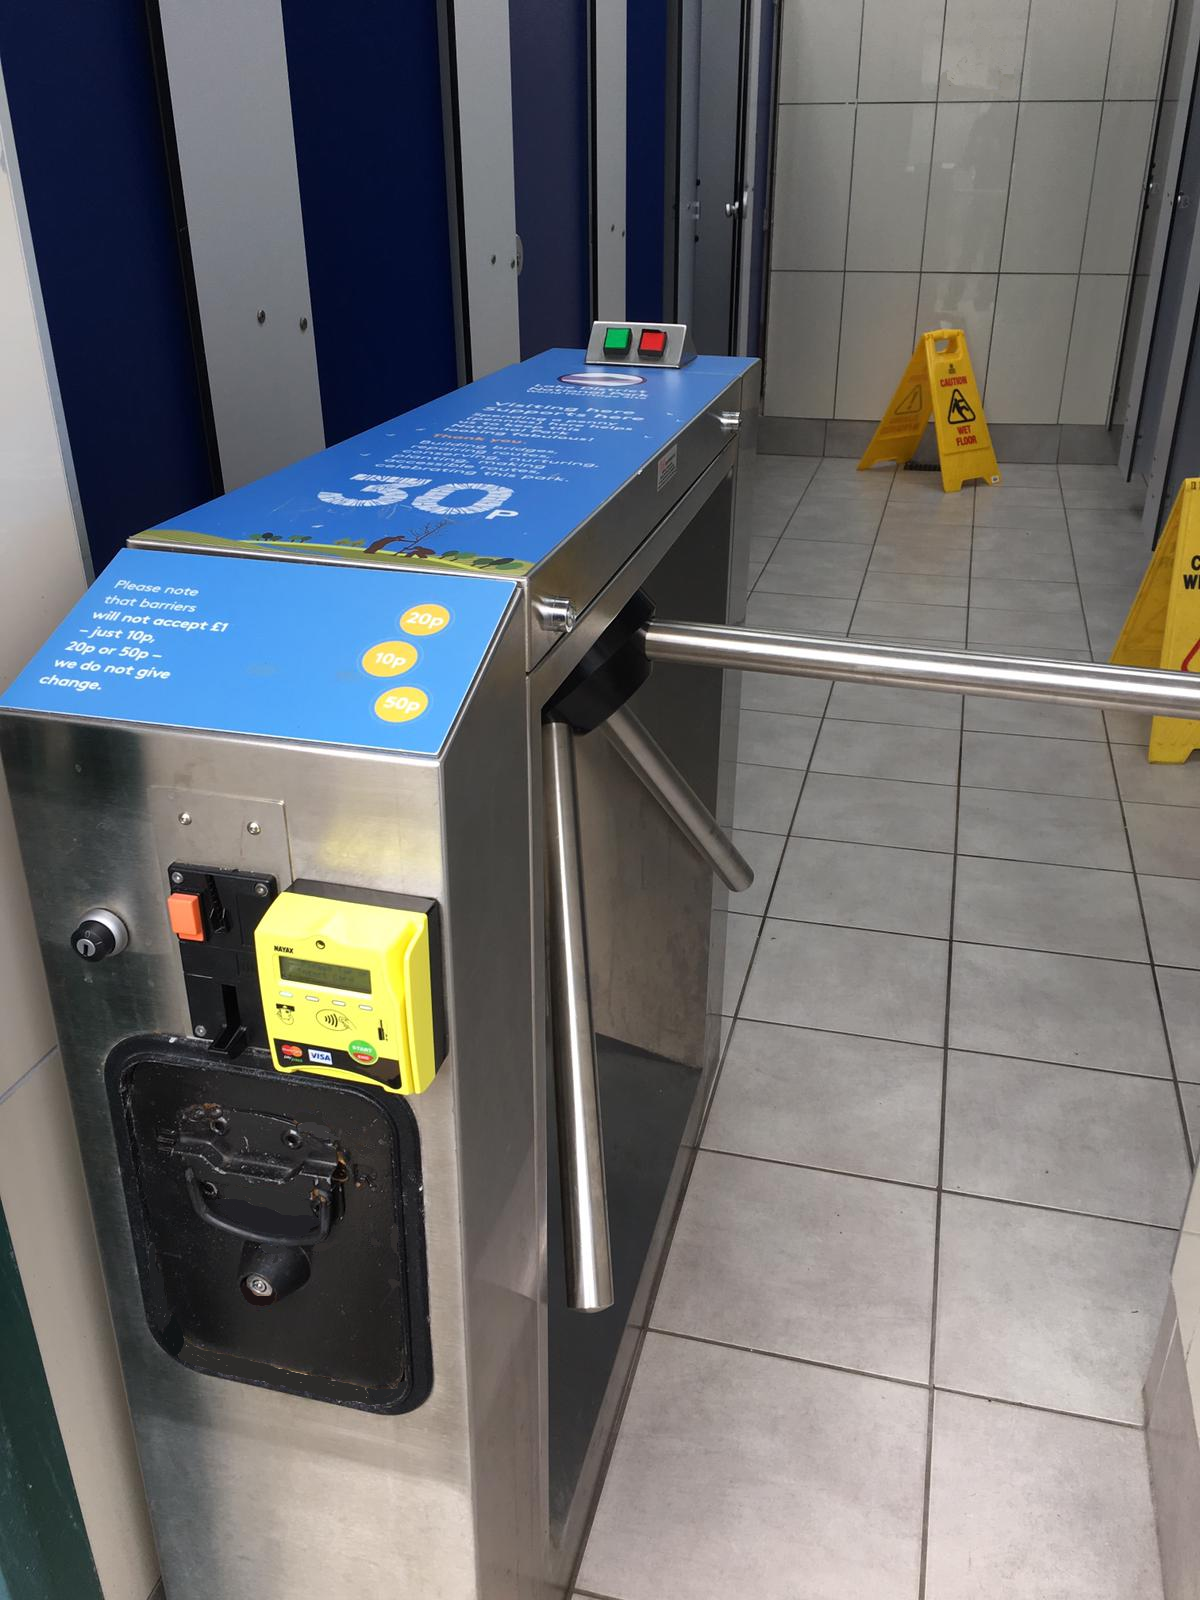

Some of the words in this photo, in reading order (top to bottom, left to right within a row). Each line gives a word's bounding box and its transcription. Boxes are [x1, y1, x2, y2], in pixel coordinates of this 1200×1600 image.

[940, 376, 968, 387] CAUTION
[482, 406, 586, 418] Supports
[496, 401, 579, 412] Visiting
[466, 416, 543, 425] (pennies)
[472, 412, 546, 422] Spending
[444, 427, 506, 436] looking
[512, 432, 594, 442] fabulous!
[452, 424, 526, 432] National
[957, 426, 972, 434] WET
[420, 440, 487, 449] Building
[492, 445, 558, 454] bridges,
[956, 436, 977, 446] FLOOR
[410, 445, 487, 454] repairing
[384, 459, 474, 468] accessible
[480, 466, 540, 474] routes,
[392, 454, 469, 463] planting,
[478, 461, 546, 469] making
[402, 450, 500, 460] conserving,
[510, 458, 600, 468] nurturing,
[375, 464, 478, 476] celebrating
[114, 579, 161, 593] Please
[164, 586, 199, 597] note
[104, 595, 136, 607] that
[139, 598, 197, 613] barriers
[92, 610, 121, 621] will
[121, 615, 151, 625] not
[153, 618, 208, 632] accept
[210, 622, 229, 633] £1
[406, 611, 444, 629] 20p
[88, 626, 123, 639] just
[126, 630, 156, 644] 10p,
[64, 641, 96, 654] 20p
[98, 648, 117, 656] or
[118, 646, 149, 661] 50p
[375, 652, 407, 668] 10p
[54, 659, 77, 670] we
[80, 660, 101, 672] do
[104, 665, 135, 676] not
[134, 667, 171, 680] give
[39, 674, 102, 692] change.
[383, 695, 420, 714] 50p
[274, 945, 294, 954] NAYAX
[311, 1052, 331, 1061] VISA
